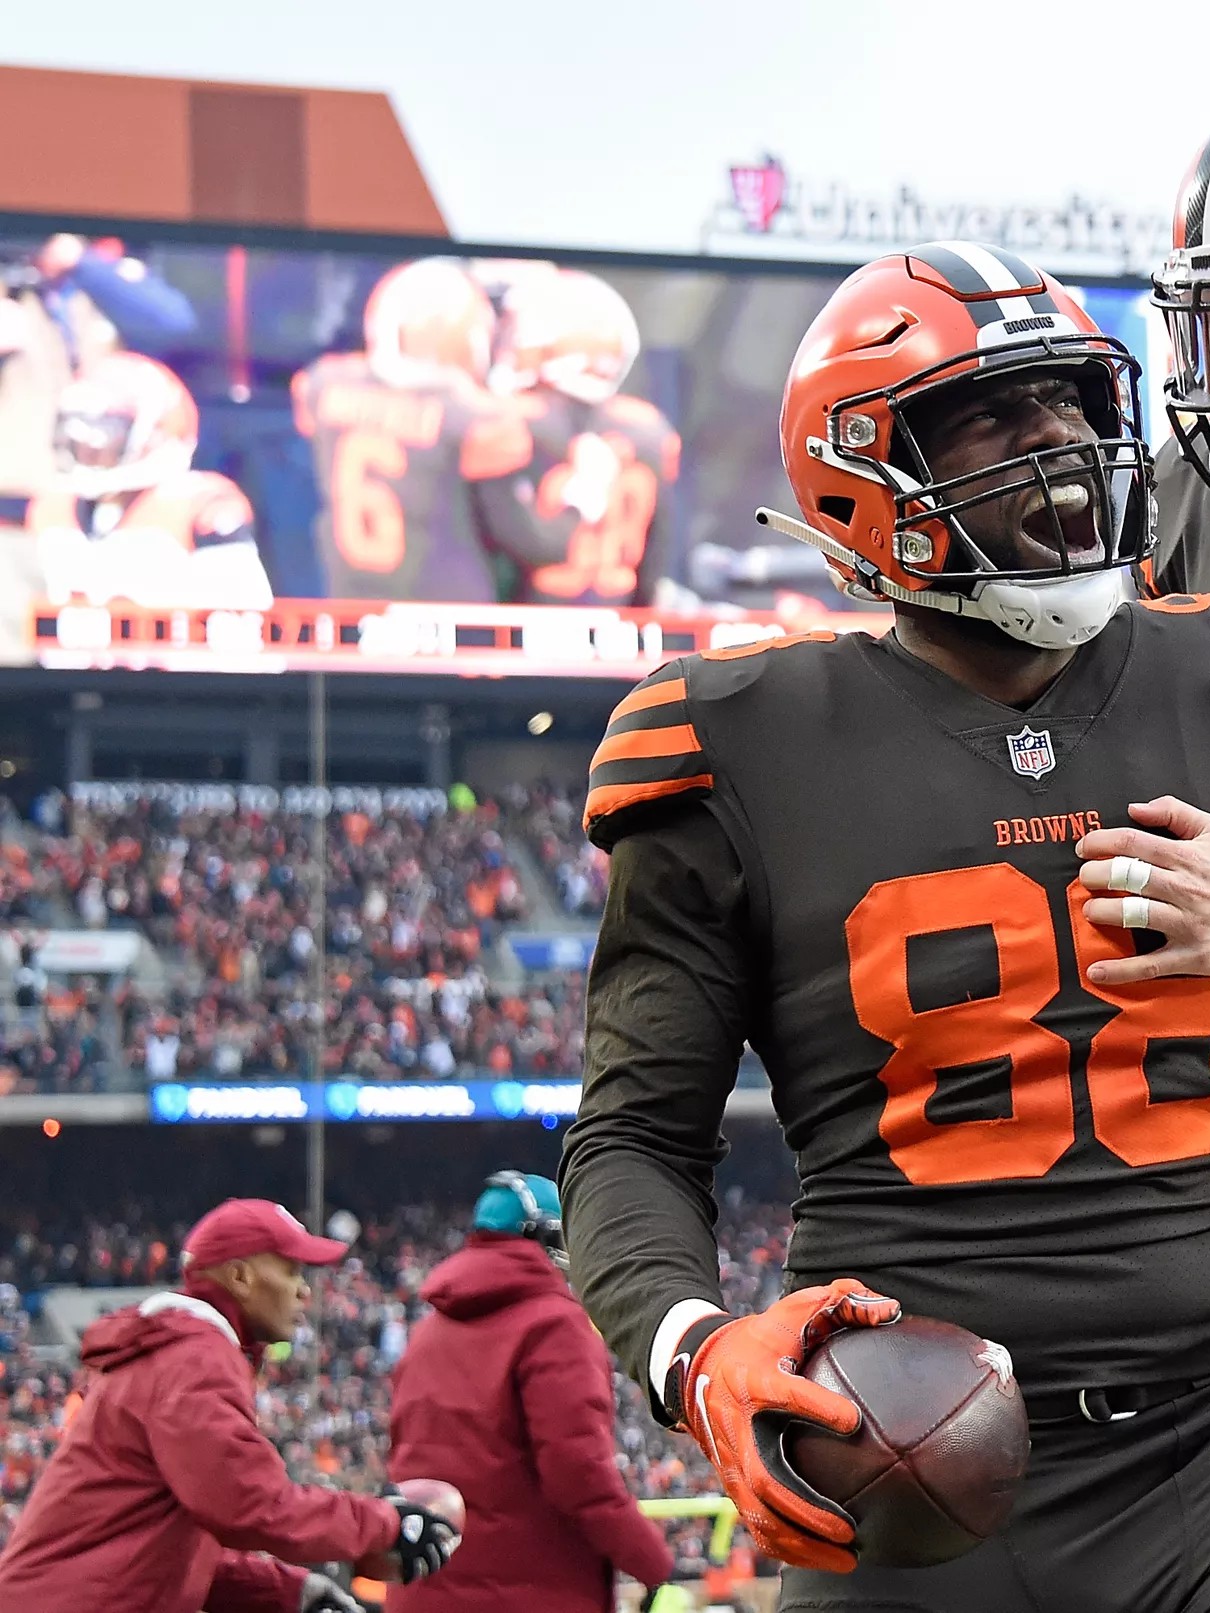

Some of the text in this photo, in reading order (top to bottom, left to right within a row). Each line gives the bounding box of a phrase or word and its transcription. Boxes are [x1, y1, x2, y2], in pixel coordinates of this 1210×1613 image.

[1003, 316, 1055, 335] BROWNS
[1018, 750, 1049, 769] NFL
[993, 810, 1101, 846] BROWNS
